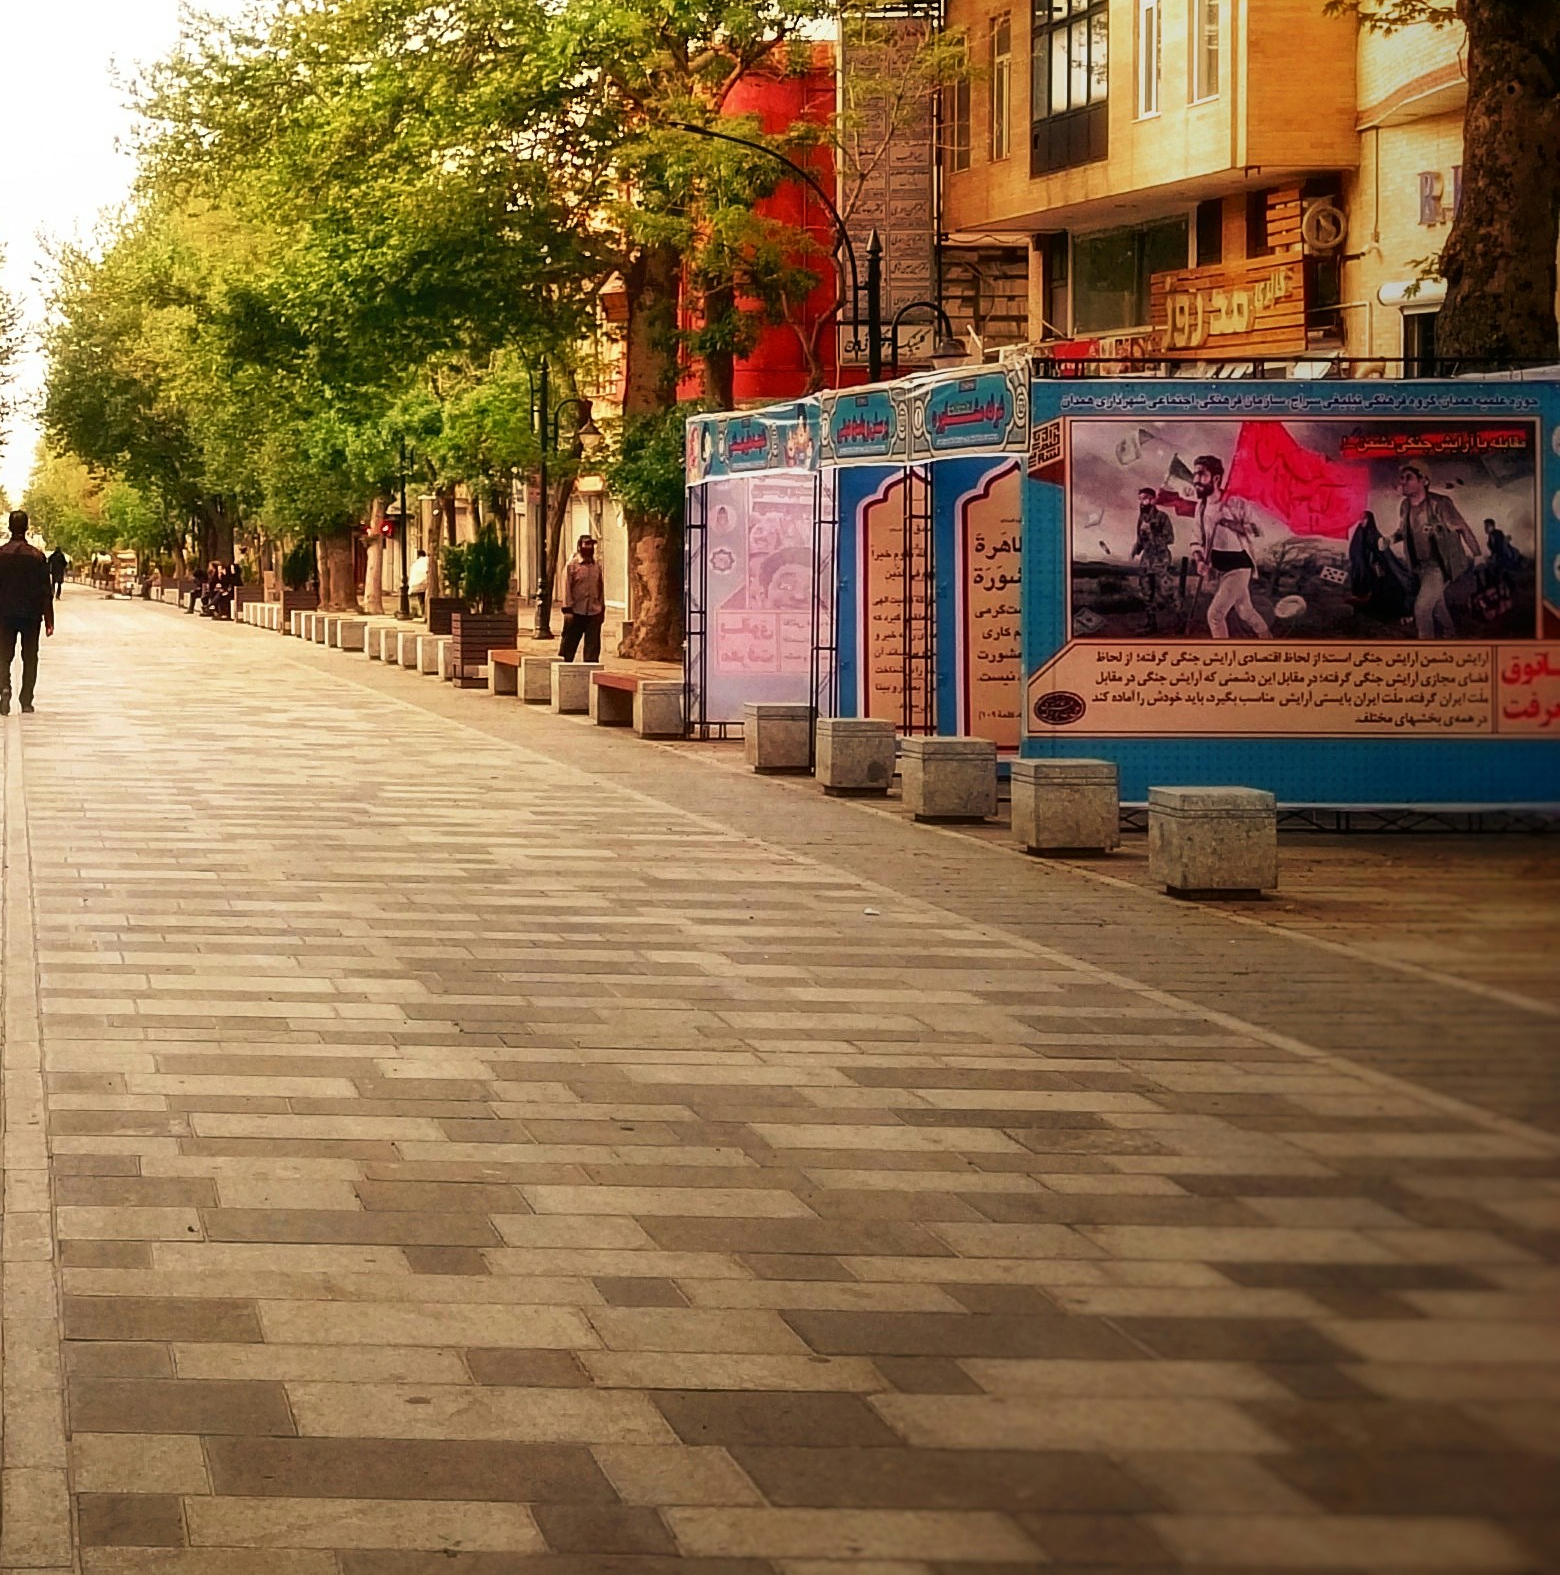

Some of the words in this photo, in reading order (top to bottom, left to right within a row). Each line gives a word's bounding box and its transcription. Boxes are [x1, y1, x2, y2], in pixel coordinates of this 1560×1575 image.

[1061, 393, 1094, 411] همدان
[1095, 393, 1146, 411] شهرداری
[1146, 393, 1195, 411] اجتماعی
[1243, 393, 1285, 411] سازمان
[1364, 393, 1407, 411] فرهنگی
[1357, 435, 1395, 452] دشمن
[1396, 435, 1433, 453] جنگی
[1435, 434, 1474, 453] آرایش
[1476, 437, 1488, 450] با
[1489, 435, 1527, 452] مقابله
[1096, 651, 1122, 663] لحاظ
[1124, 651, 1133, 667] از
[1171, 651, 1200, 667] جنگی
[1203, 650, 1237, 667] آرایش
[1238, 651, 1282, 667] اقتصادی
[1283, 651, 1311, 663] لحاظ
[1312, 652, 1321, 667] از
[1353, 651, 1383, 668] جنگی
[1385, 650, 1419, 668] آرایش
[1420, 651, 1454, 668] دشمن
[1455, 651, 1490, 668] آرایش
[1095, 670, 1123, 686] مقابل
[1124, 674, 1135, 687] در
[1137, 671, 1167, 687] جنگی
[1169, 670, 1202, 687] آرایش
[1204, 671, 1217, 683] که
[1218, 671, 1256, 687] دشمنی
[1258, 671, 1276, 687] این
[1277, 671, 1305, 687] مقابل
[1306, 674, 1318, 688] در
[1353, 671, 1384, 688] جنگی
[1385, 671, 1419, 688] آرایش
[1420, 672, 1455, 688] مجازی
[1457, 672, 1489, 688] فضای
[1091, 691, 1110, 703] کند
[1111, 689, 1135, 702] آماده
[1137, 691, 1145, 707] را
[1146, 690, 1182, 707] خودش
[1184, 691, 1204, 706] باید
[1238, 691, 1275, 706] مناسب
[1279, 690, 1313, 708] آرایش
[1313, 692, 1352, 708] بایستی
[1353, 692, 1380, 708] ایران
[1439, 692, 1466, 708] ایران
[1476, 715, 1488, 728] در
